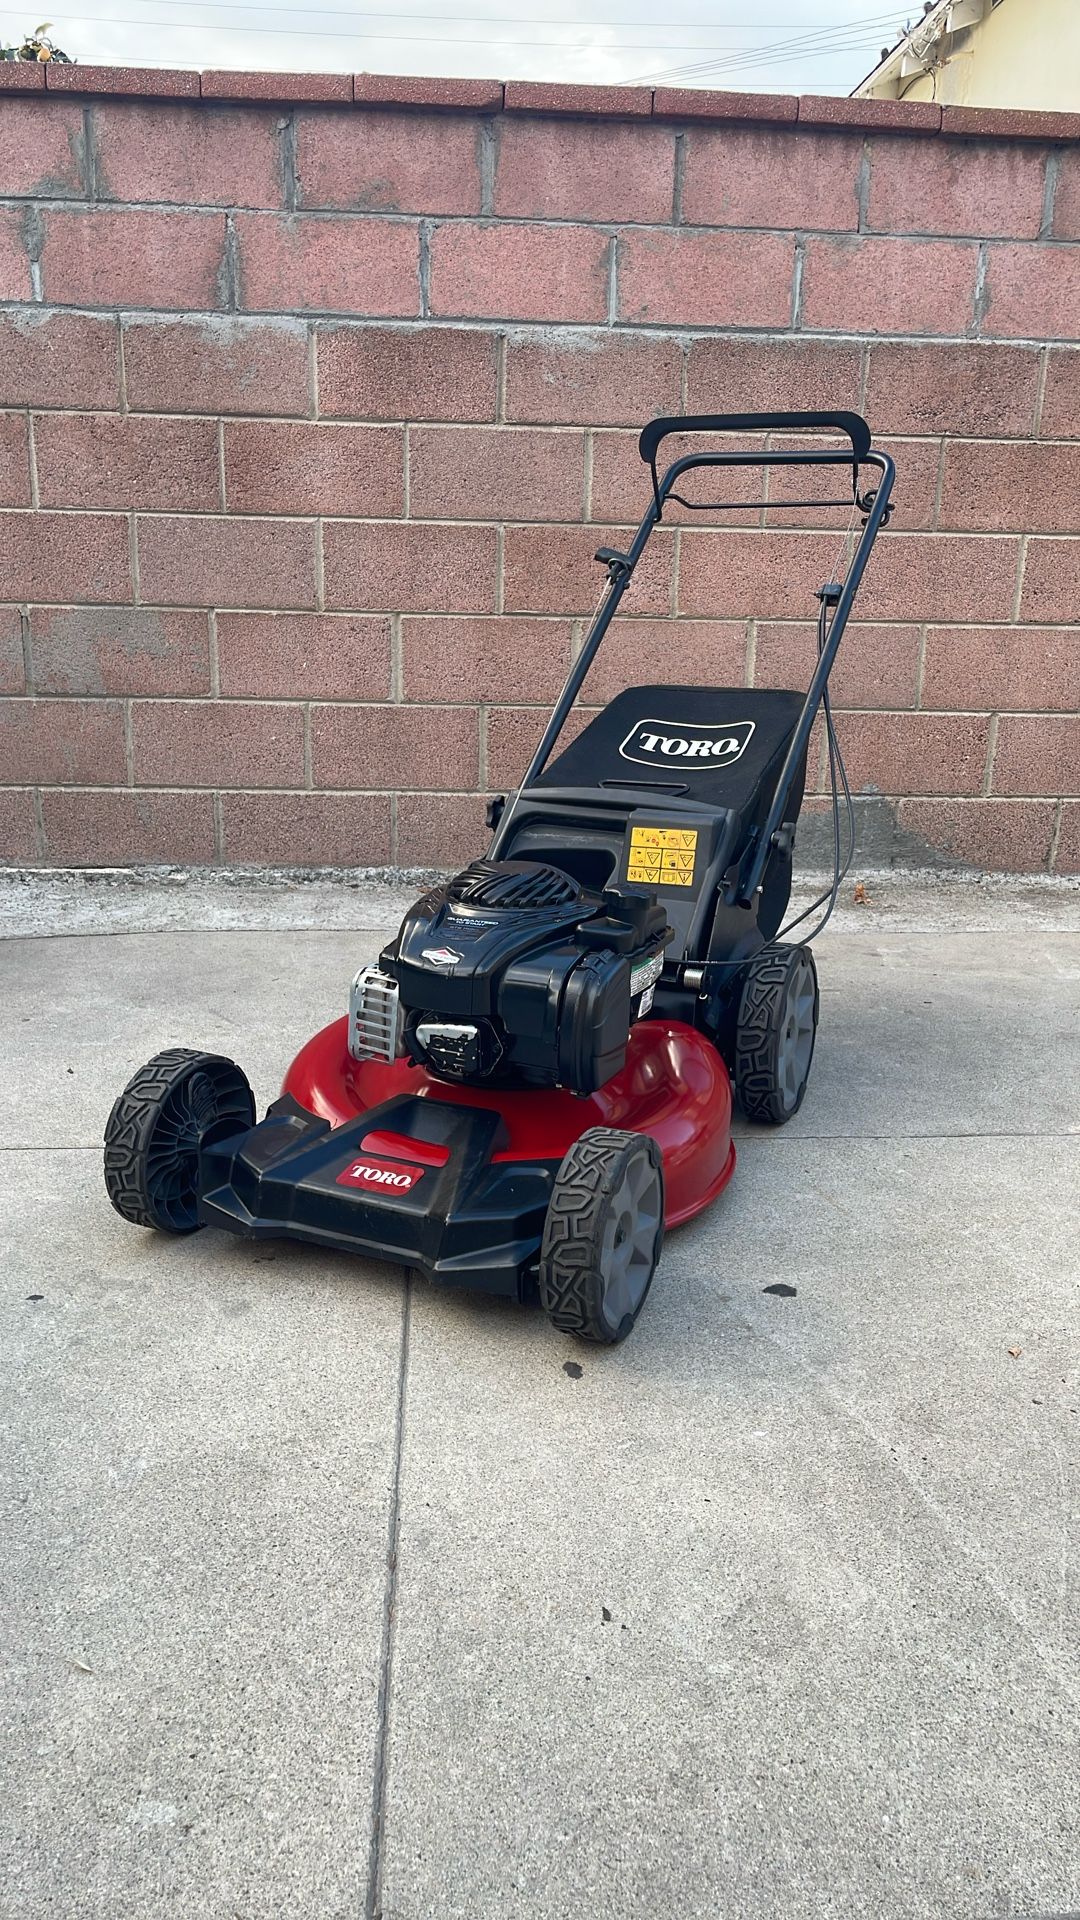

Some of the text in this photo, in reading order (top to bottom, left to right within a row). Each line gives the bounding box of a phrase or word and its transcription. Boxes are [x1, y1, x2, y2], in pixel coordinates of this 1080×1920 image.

[639, 732, 740, 757] TORO
[447, 916, 499, 926] GUARANTEED
[350, 1165, 411, 1187] TORO
